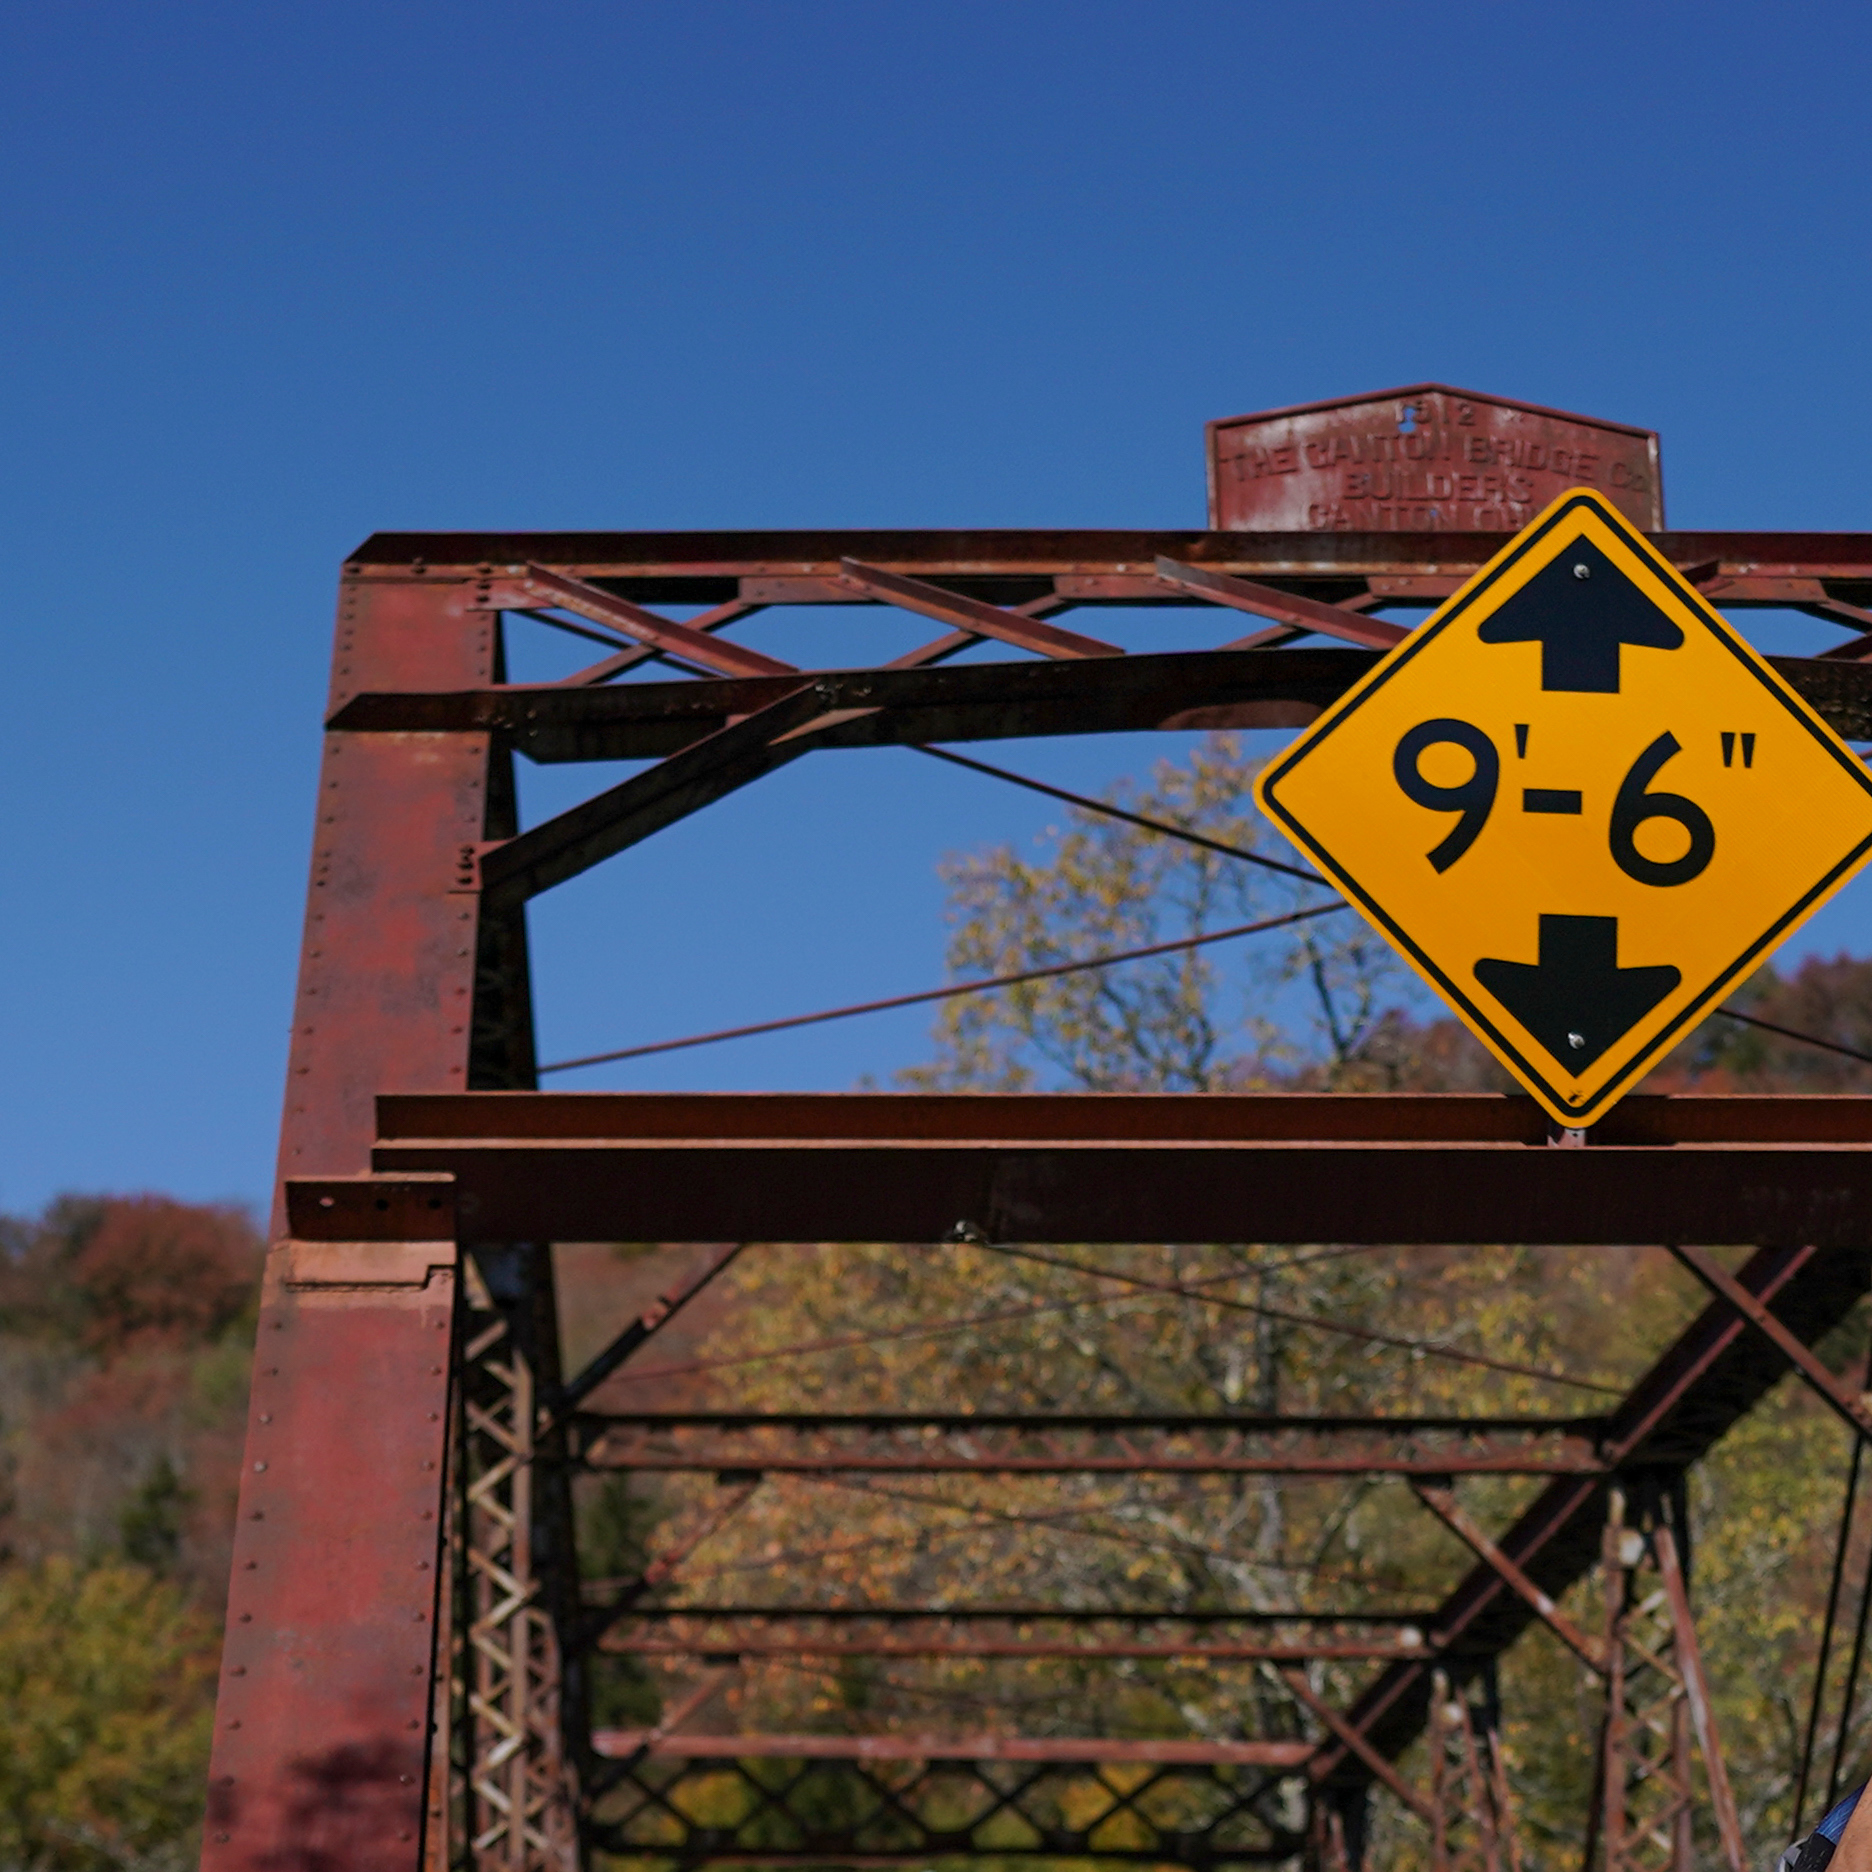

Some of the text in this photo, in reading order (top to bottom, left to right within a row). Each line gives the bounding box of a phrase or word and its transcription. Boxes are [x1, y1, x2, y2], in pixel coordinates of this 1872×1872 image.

[1218, 446, 1299, 482] THE
[1463, 434, 1599, 482] BRIDGE
[1343, 471, 1534, 504] BUILDERS
